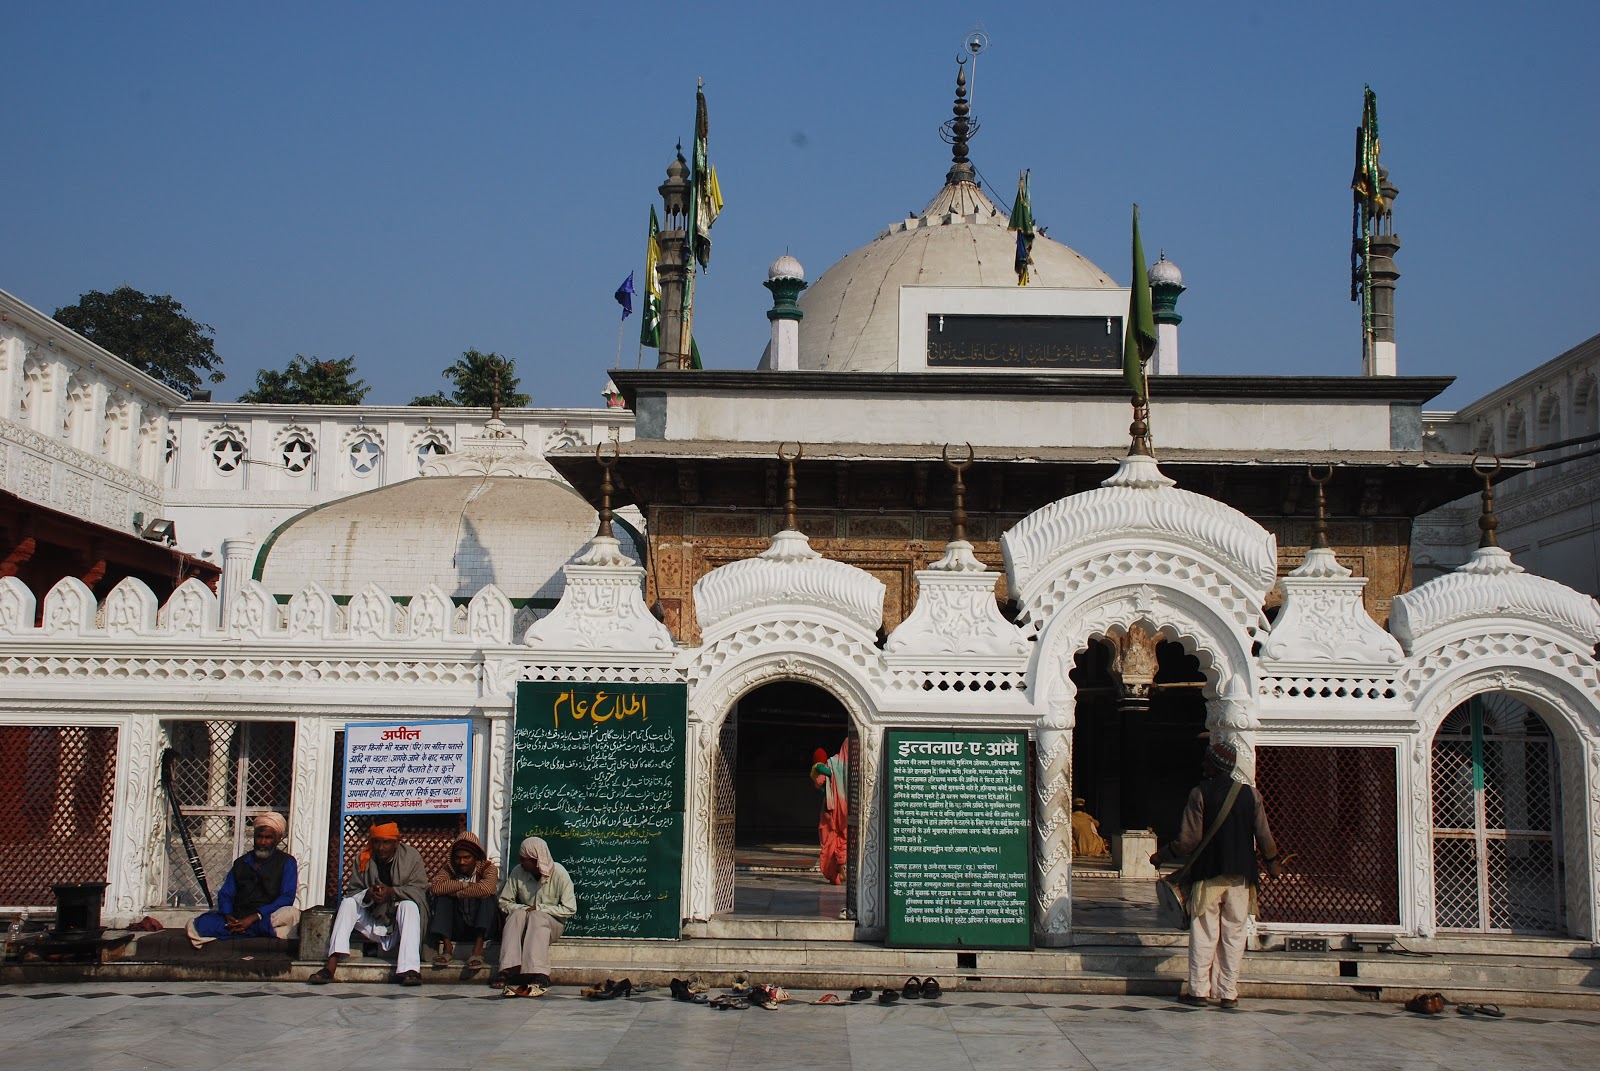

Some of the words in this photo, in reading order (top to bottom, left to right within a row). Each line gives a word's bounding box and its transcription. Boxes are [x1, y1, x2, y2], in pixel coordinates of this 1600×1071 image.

[553, 688, 589, 729] عام
[380, 726, 422, 741] अपील
[611, 729, 631, 742] زیارت
[630, 729, 645, 742] تمام
[641, 724, 653, 741] کی
[648, 733, 664, 741] پت
[663, 725, 676, 743] پانی
[367, 742, 385, 752] किसी
[384, 741, 394, 751] भी
[423, 743, 432, 751] पर
[531, 737, 540, 751] کی
[348, 752, 364, 763] आदि
[390, 751, 408, 763] आपके
[407, 751, 421, 762] जाने
[421, 751, 428, 762] के
[427, 753, 439, 763] बाद
[455, 753, 464, 762] पर
[386, 762, 406, 775] गन्दगी
[364, 775, 376, 786] को
[347, 789, 370, 798] अपमान
[405, 788, 414, 798] पर
[414, 786, 430, 797] सिर्फ
[400, 797, 423, 809] अधिकारी
[647, 814, 656, 825] کے
